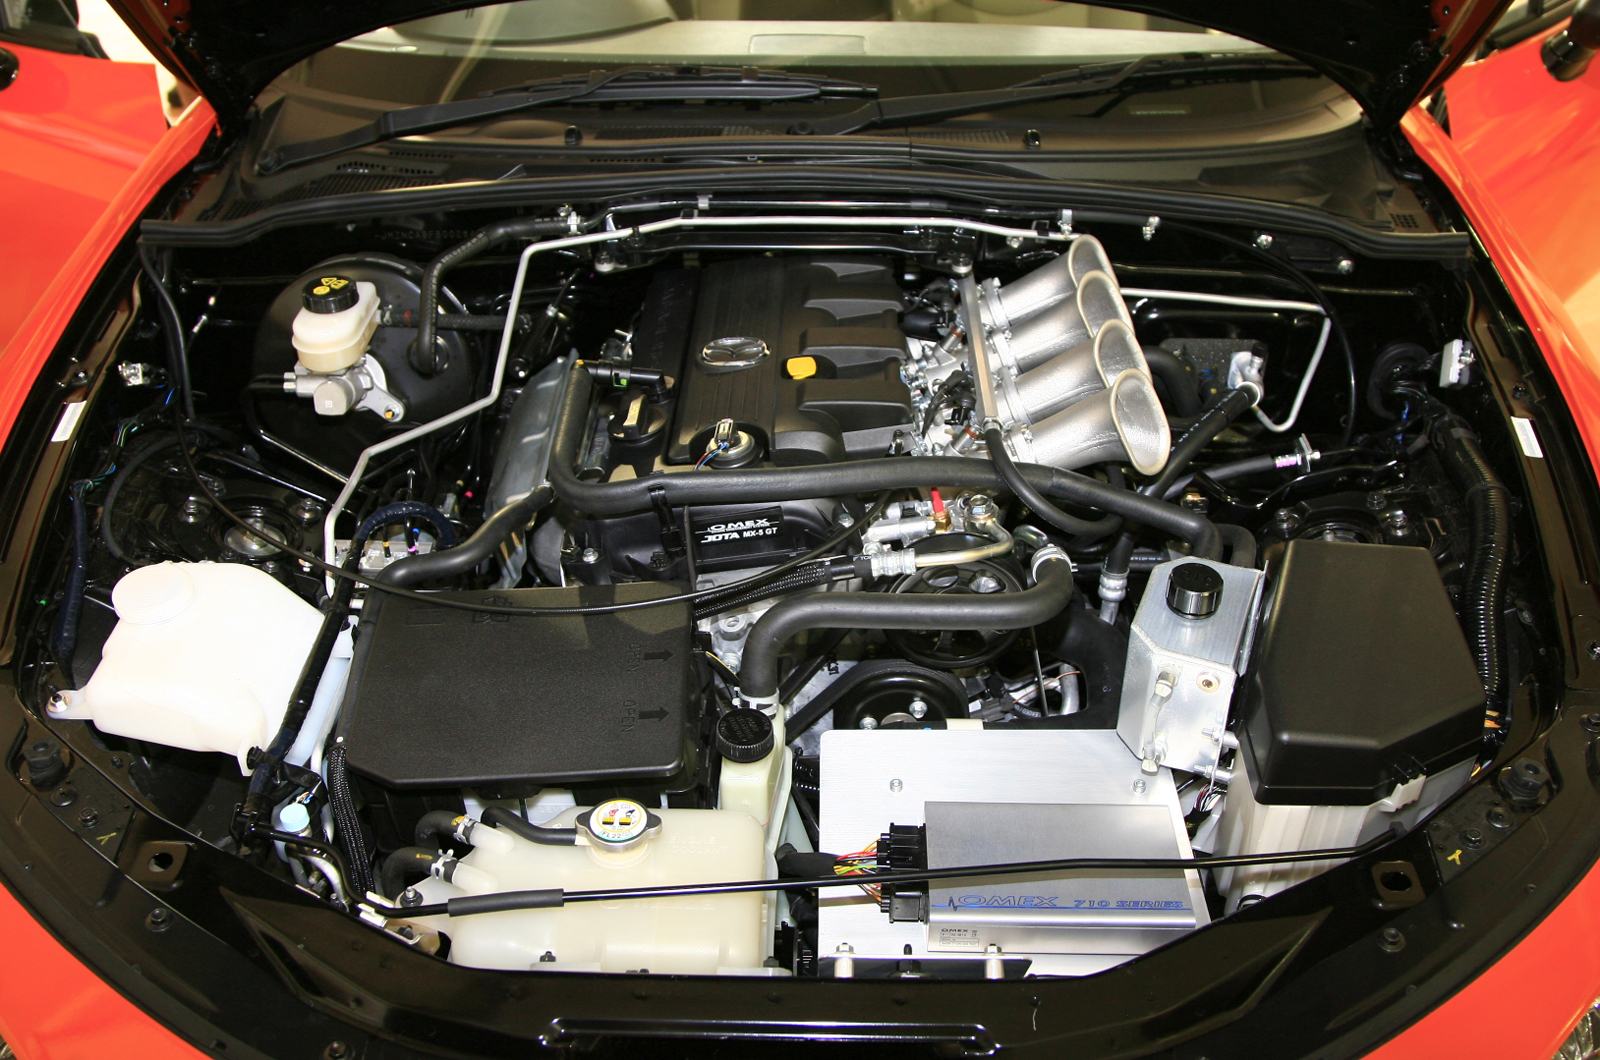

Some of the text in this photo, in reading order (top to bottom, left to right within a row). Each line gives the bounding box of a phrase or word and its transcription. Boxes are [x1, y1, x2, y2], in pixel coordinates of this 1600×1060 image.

[709, 518, 769, 532] OMEX
[701, 532, 740, 543] JOTA
[743, 529, 764, 538] MX-5
[765, 527, 778, 535] GT
[626, 642, 642, 671] OPEN
[620, 699, 637, 732] OPEN
[602, 830, 622, 839] FL22
[669, 836, 717, 844] ENGINE
[671, 845, 728, 855] COOLANT
[957, 894, 1184, 908] OMEX 710 SERIES
